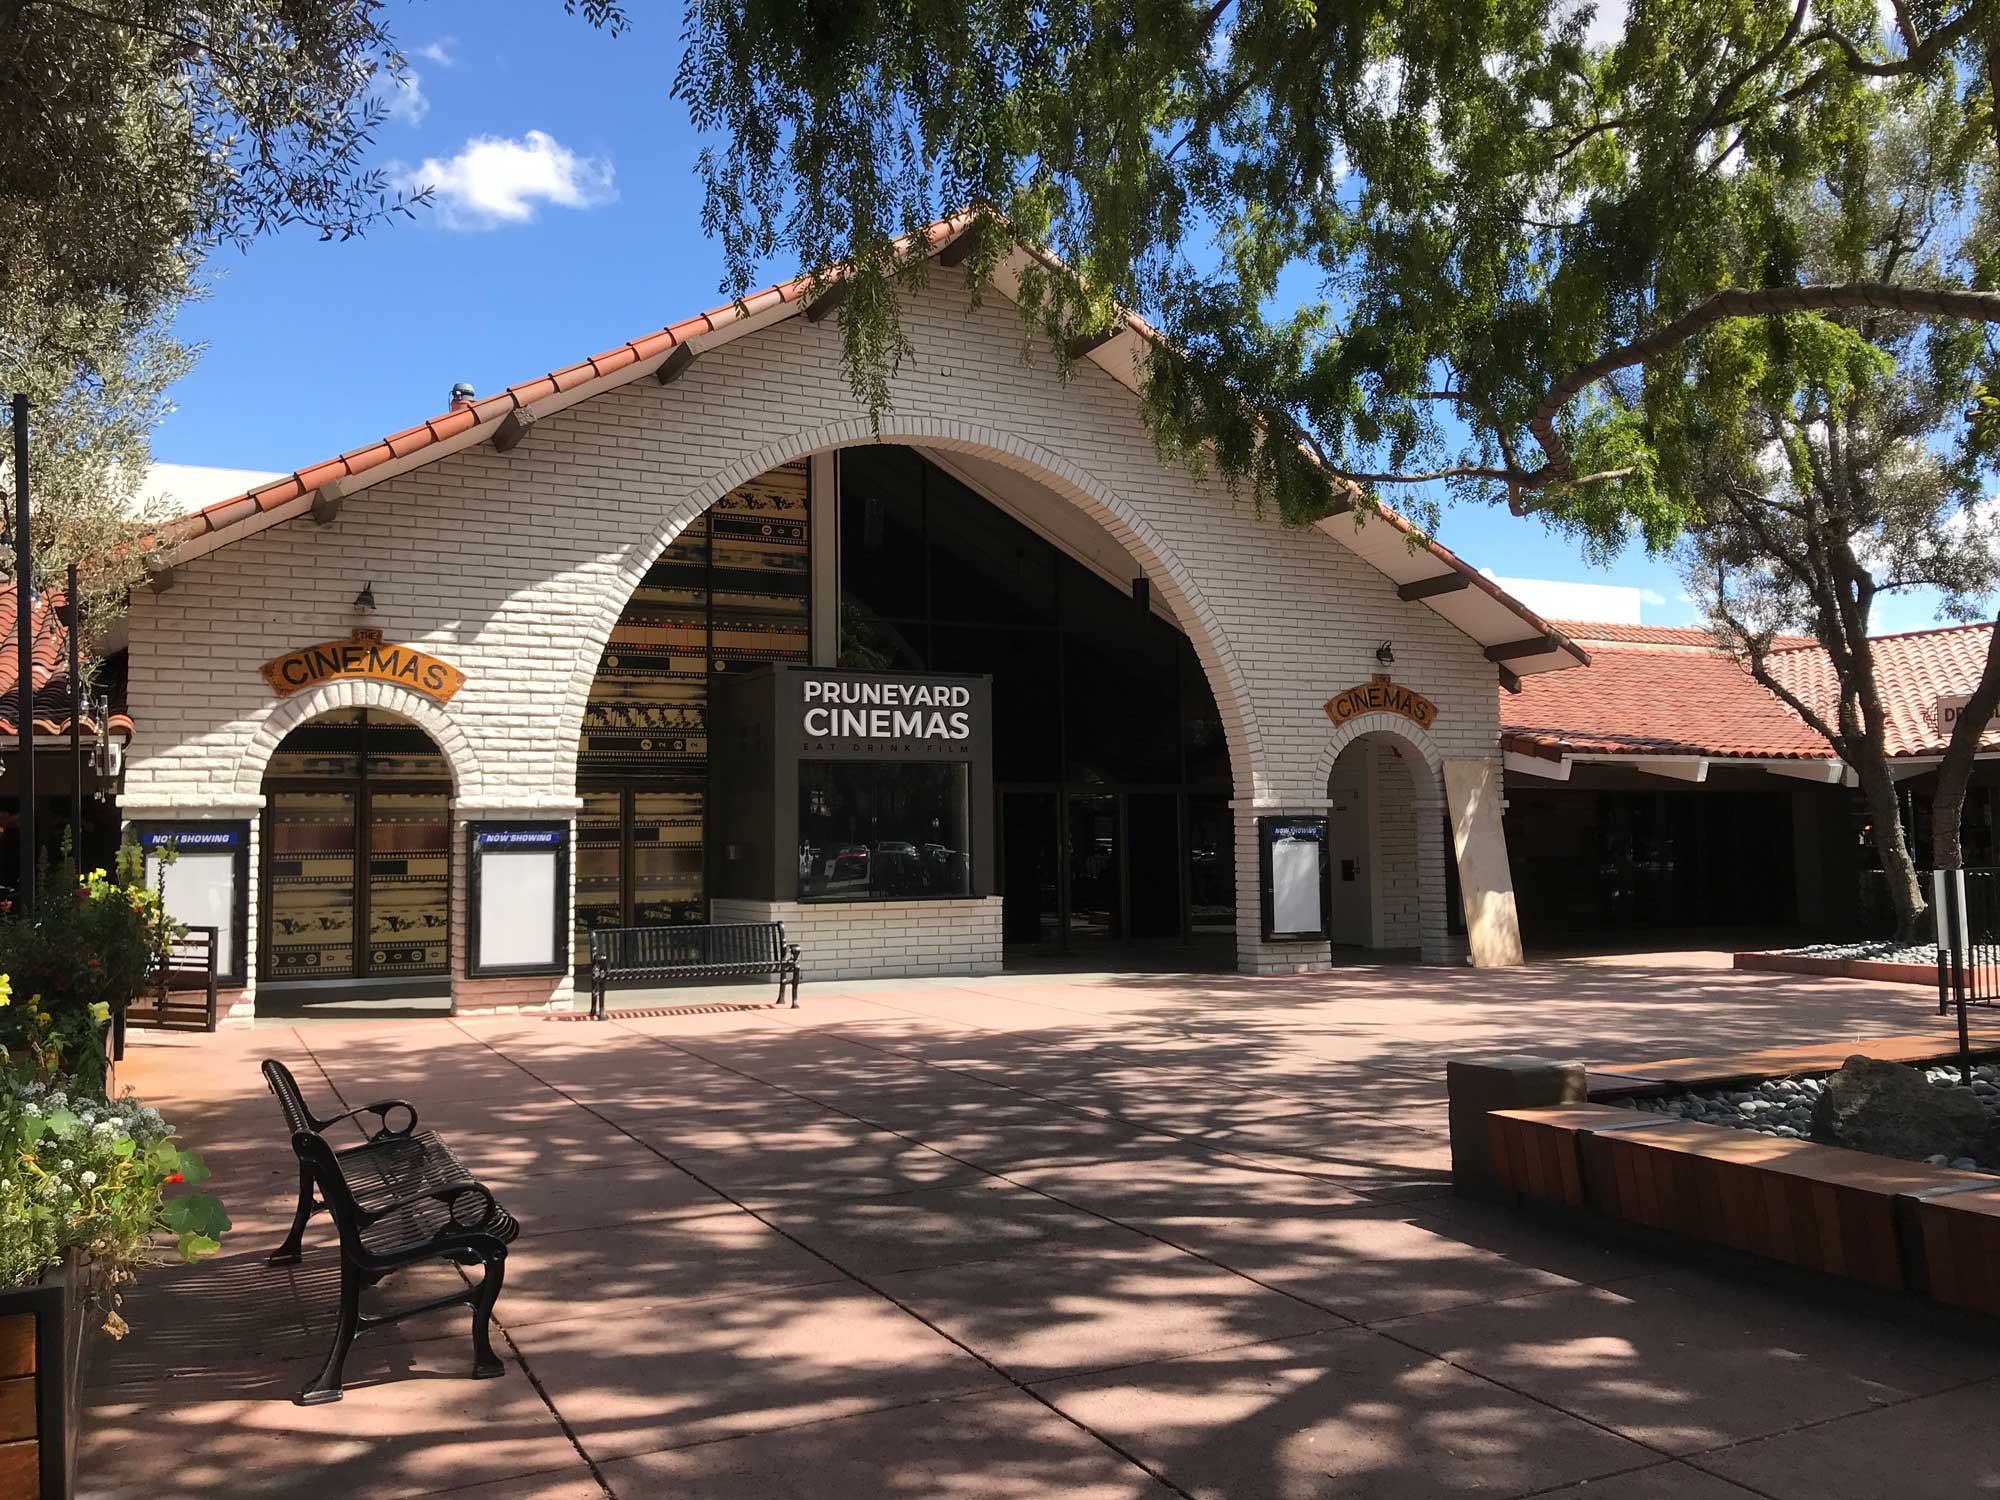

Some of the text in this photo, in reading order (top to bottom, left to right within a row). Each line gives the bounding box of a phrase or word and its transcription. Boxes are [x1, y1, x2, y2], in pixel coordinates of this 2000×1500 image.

[360, 631, 377, 640] THE
[281, 646, 448, 690] CINEMAS
[803, 680, 970, 707] PRUNEYARD
[1336, 687, 1429, 720] CINEMAS
[803, 707, 970, 739] CINEMAS
[803, 743, 969, 753] EAT DRINK FILM
[180, 834, 230, 843] SHOWING
[486, 834, 552, 842] NOW SHOWING
